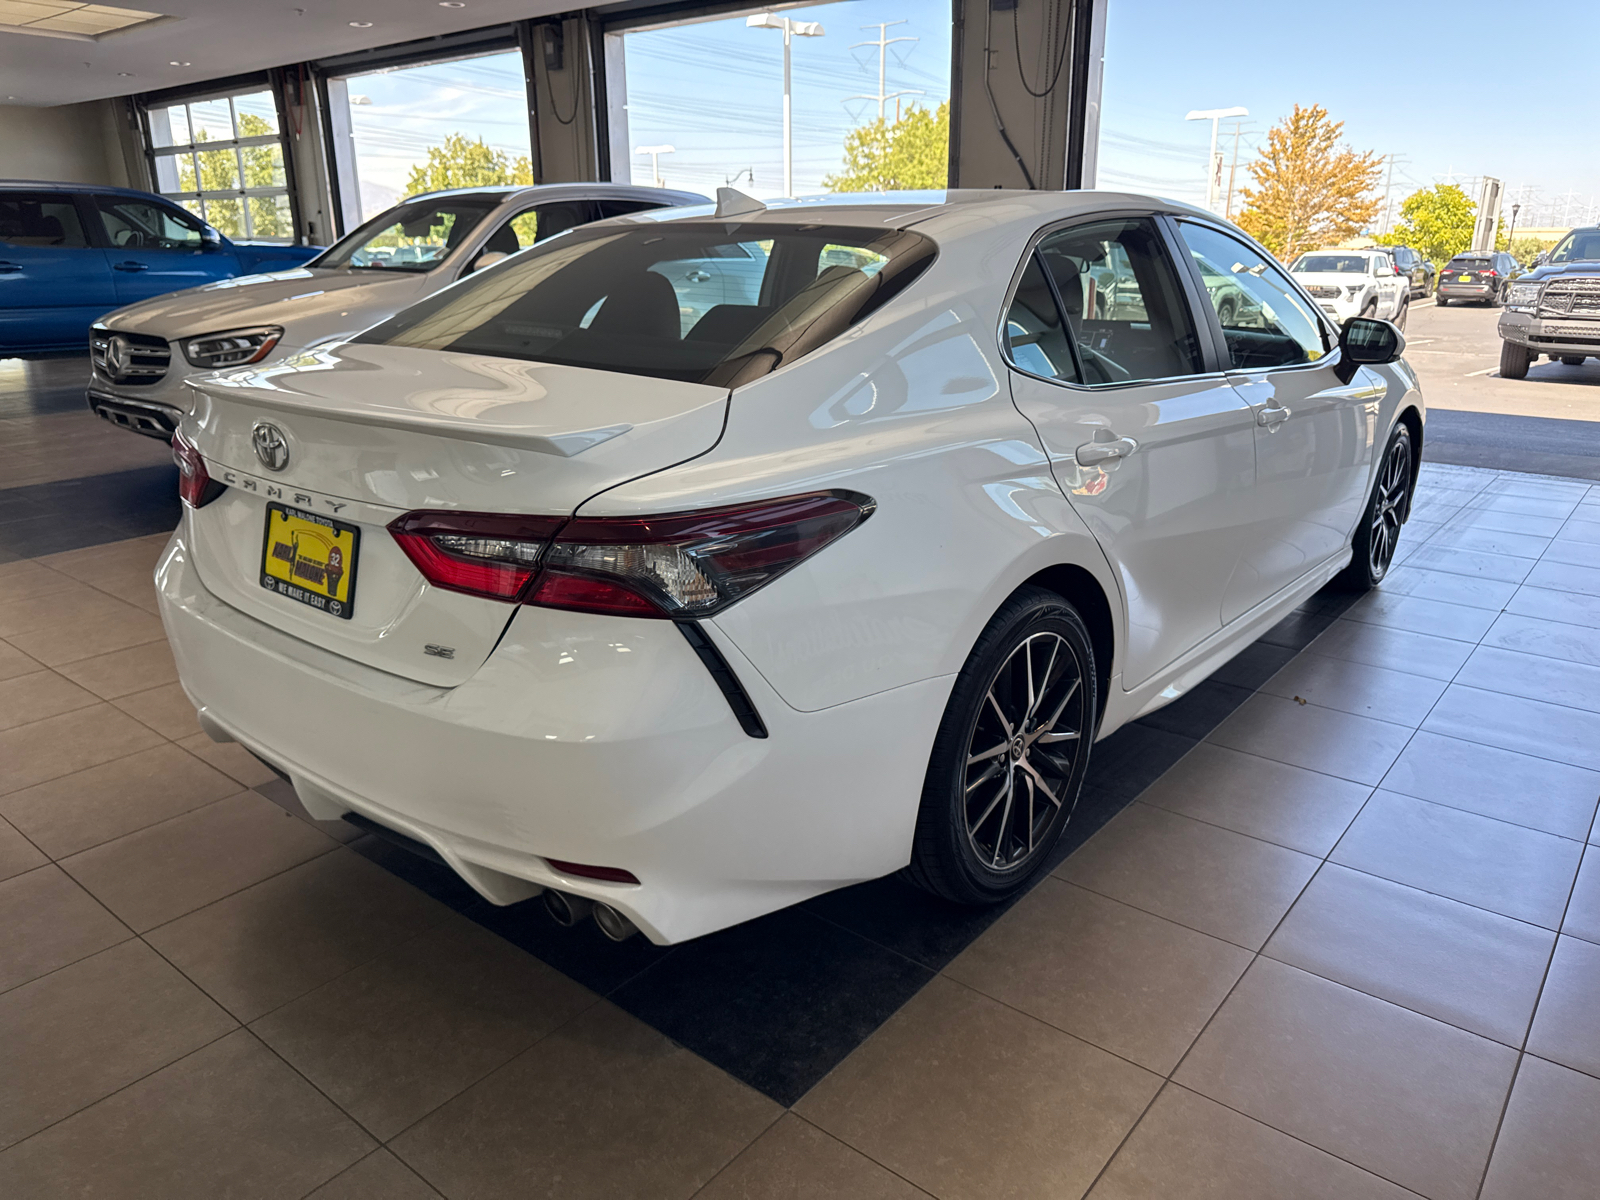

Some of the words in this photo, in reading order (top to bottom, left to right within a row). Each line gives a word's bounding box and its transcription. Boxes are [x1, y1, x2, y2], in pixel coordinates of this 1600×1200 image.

[223, 472, 347, 513] CAMRY
[330, 552, 341, 567] 32
[278, 581, 288, 595] WE
[288, 585, 304, 601] MAKE
[303, 591, 311, 604] IT
[310, 594, 326, 609] EASY
[423, 643, 456, 659] SE
